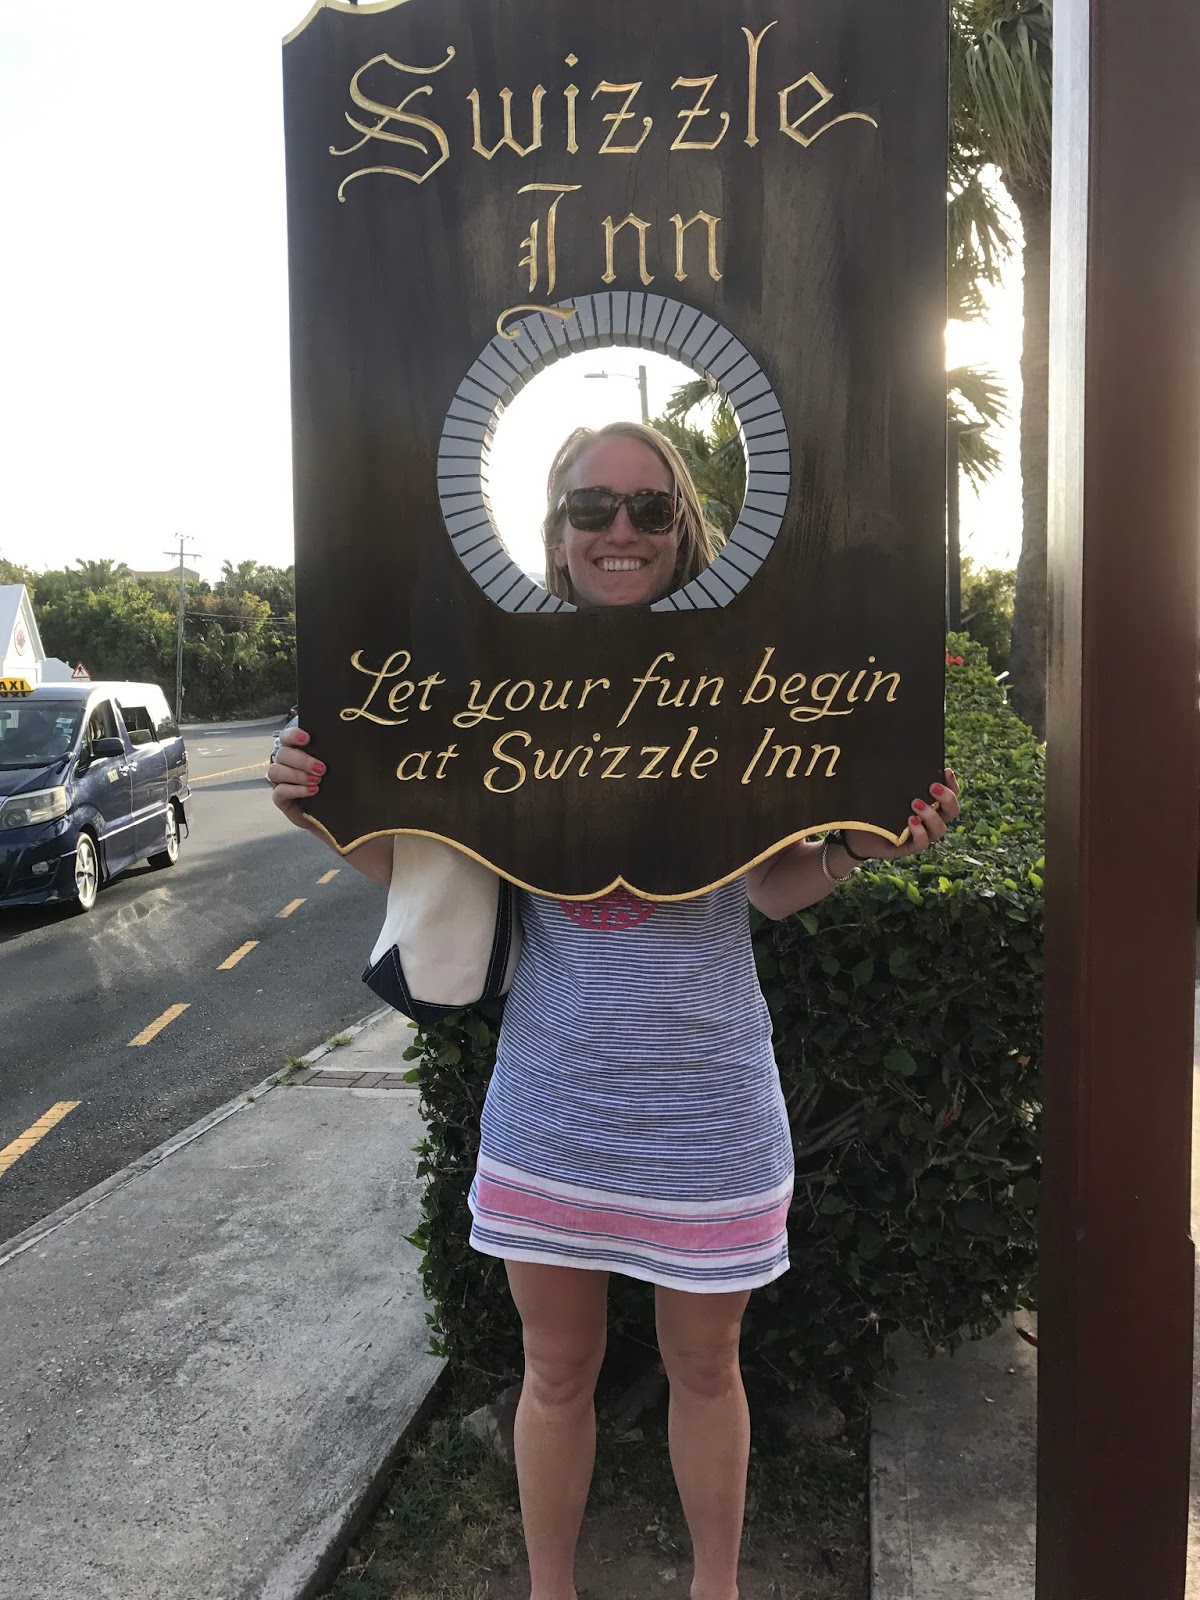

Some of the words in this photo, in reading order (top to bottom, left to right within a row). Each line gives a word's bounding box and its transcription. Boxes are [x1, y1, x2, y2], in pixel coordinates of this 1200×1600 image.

[328, 20, 878, 203] Swizzle
[496, 183, 723, 339] Inn
[338, 649, 447, 727] Let
[452, 676, 611, 729] your
[616, 651, 725, 728] fun
[741, 646, 902, 723] begin
[395, 743, 458, 782] at
[483, 726, 720, 794] Swizzle
[740, 727, 842, 785] Inn
